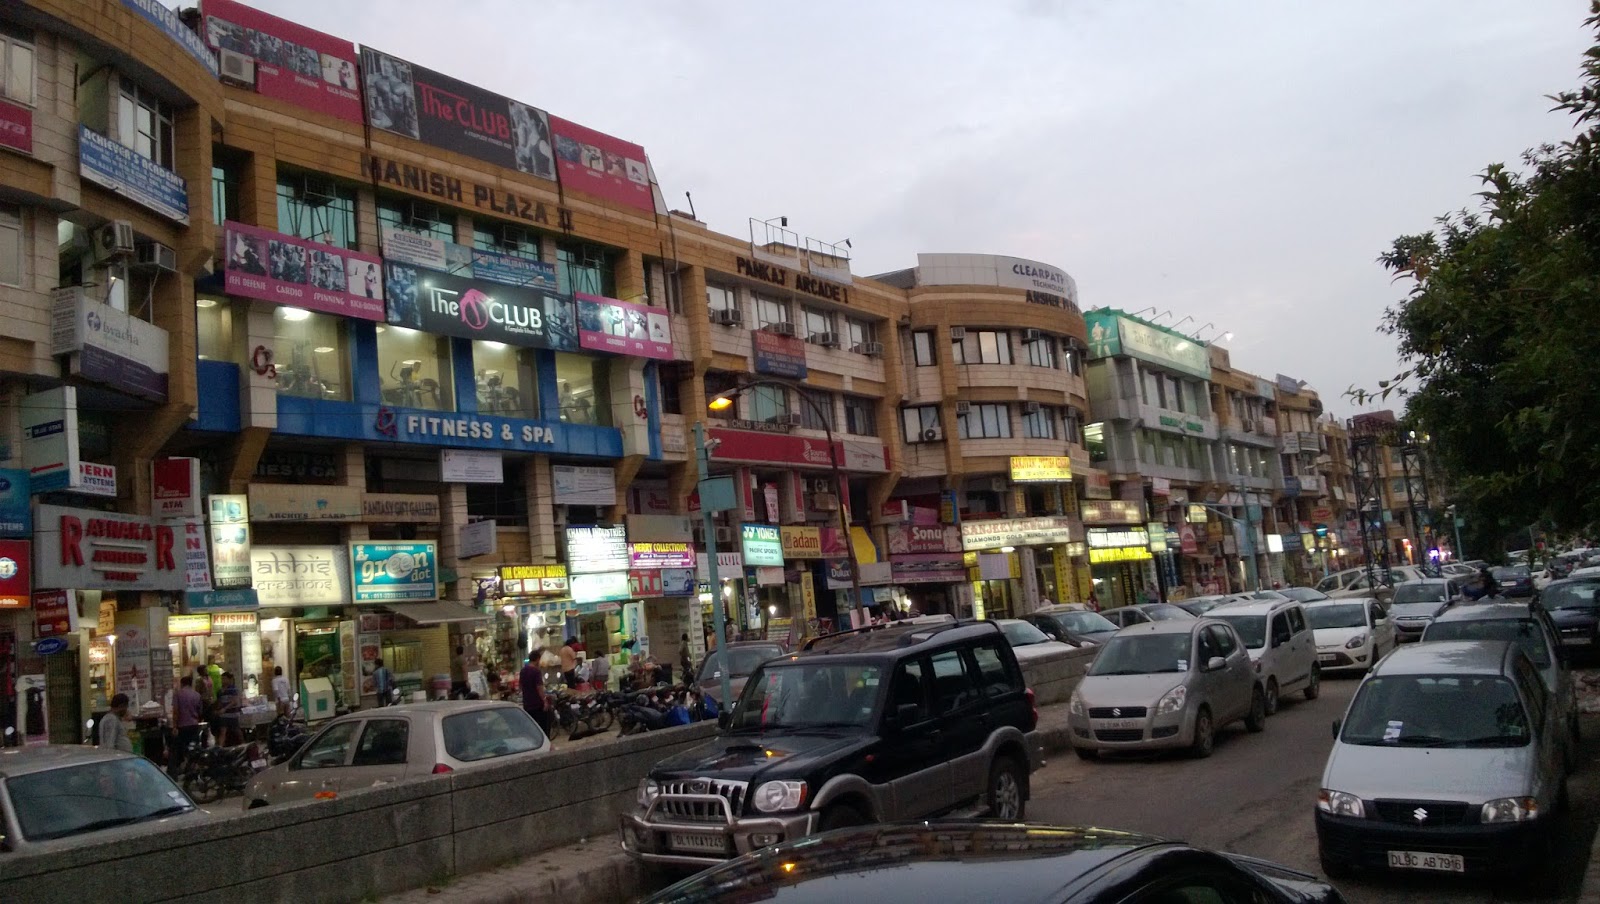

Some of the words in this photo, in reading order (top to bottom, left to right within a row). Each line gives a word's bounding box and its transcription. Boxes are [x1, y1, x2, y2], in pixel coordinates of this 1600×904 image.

[456, 100, 510, 140] CLUB
[360, 153, 463, 203] MANISH
[474, 184, 549, 225] PLAZA
[736, 256, 786, 286] PANKAJ
[795, 274, 840, 302] ARCADE
[276, 285, 303, 298] CARDIO
[313, 292, 345, 306] SPINNING
[427, 286, 460, 316] The
[488, 302, 543, 329] CLUB
[407, 415, 493, 440] FITNESS
[502, 424, 514, 441] &
[522, 425, 555, 444] SPA
[732, 419, 751, 429] CHILD
[754, 421, 789, 432] SPECIALIST
[84, 477, 115, 488] SYSTEMS
[162, 502, 183, 510] ATM
[363, 500, 394, 515] FANTASY
[409, 501, 437, 516] GALLERY
[186, 522, 198, 534] R
[756, 526, 779, 540] YONEX
[912, 526, 942, 541] Sonu
[186, 538, 200, 549] N
[793, 531, 819, 549] adam
[967, 536, 1001, 545] DIAMONDS
[361, 551, 428, 583] green
[513, 565, 546, 579] CROCKERY
[546, 565, 567, 578] HOUSE
[831, 568, 850, 578] Dulux
[411, 569, 431, 582] dot
[213, 614, 255, 624] KRISHNA
